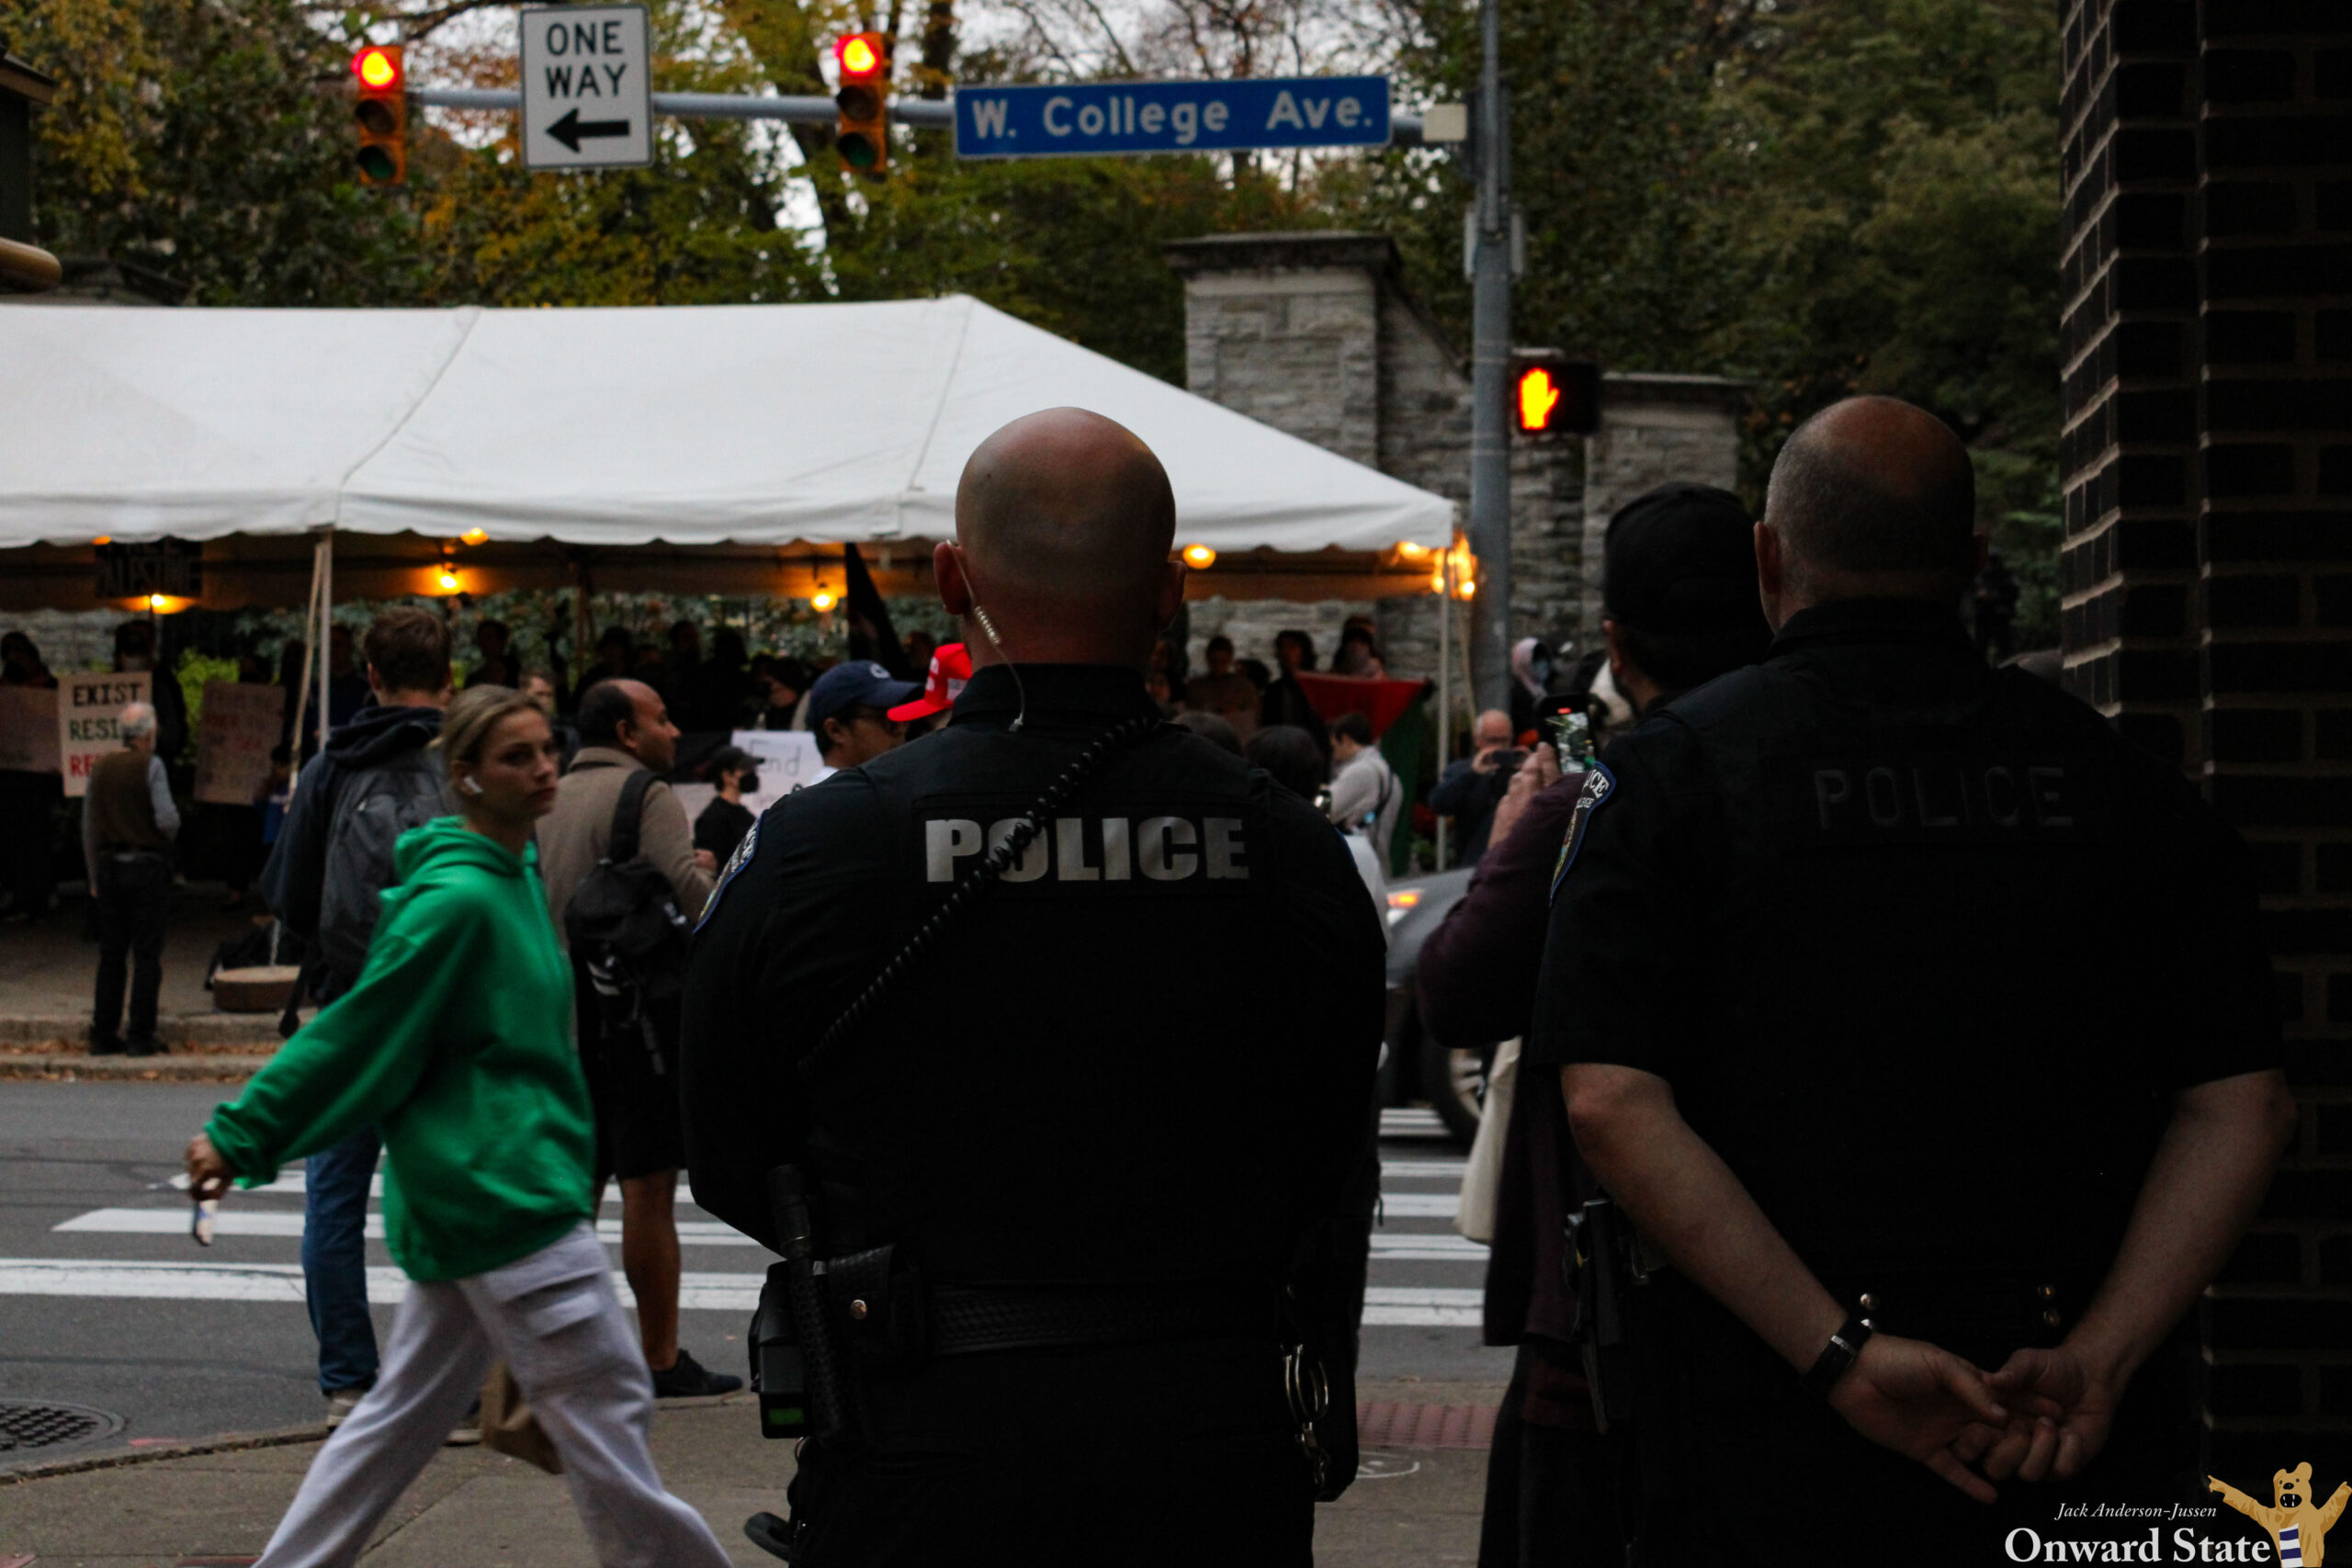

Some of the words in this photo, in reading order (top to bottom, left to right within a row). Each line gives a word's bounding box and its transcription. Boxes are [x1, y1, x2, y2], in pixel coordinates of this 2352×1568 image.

[547, 21, 623, 55] ONE
[546, 63, 627, 97] WAY
[971, 98, 1016, 139] W.
[1043, 95, 1230, 145] College
[1266, 90, 1373, 130] Ave.
[73, 682, 142, 706] EXIST
[69, 717, 119, 740] RESI
[1815, 765, 2075, 829] POLICE
[925, 816, 1250, 882] POLICE
